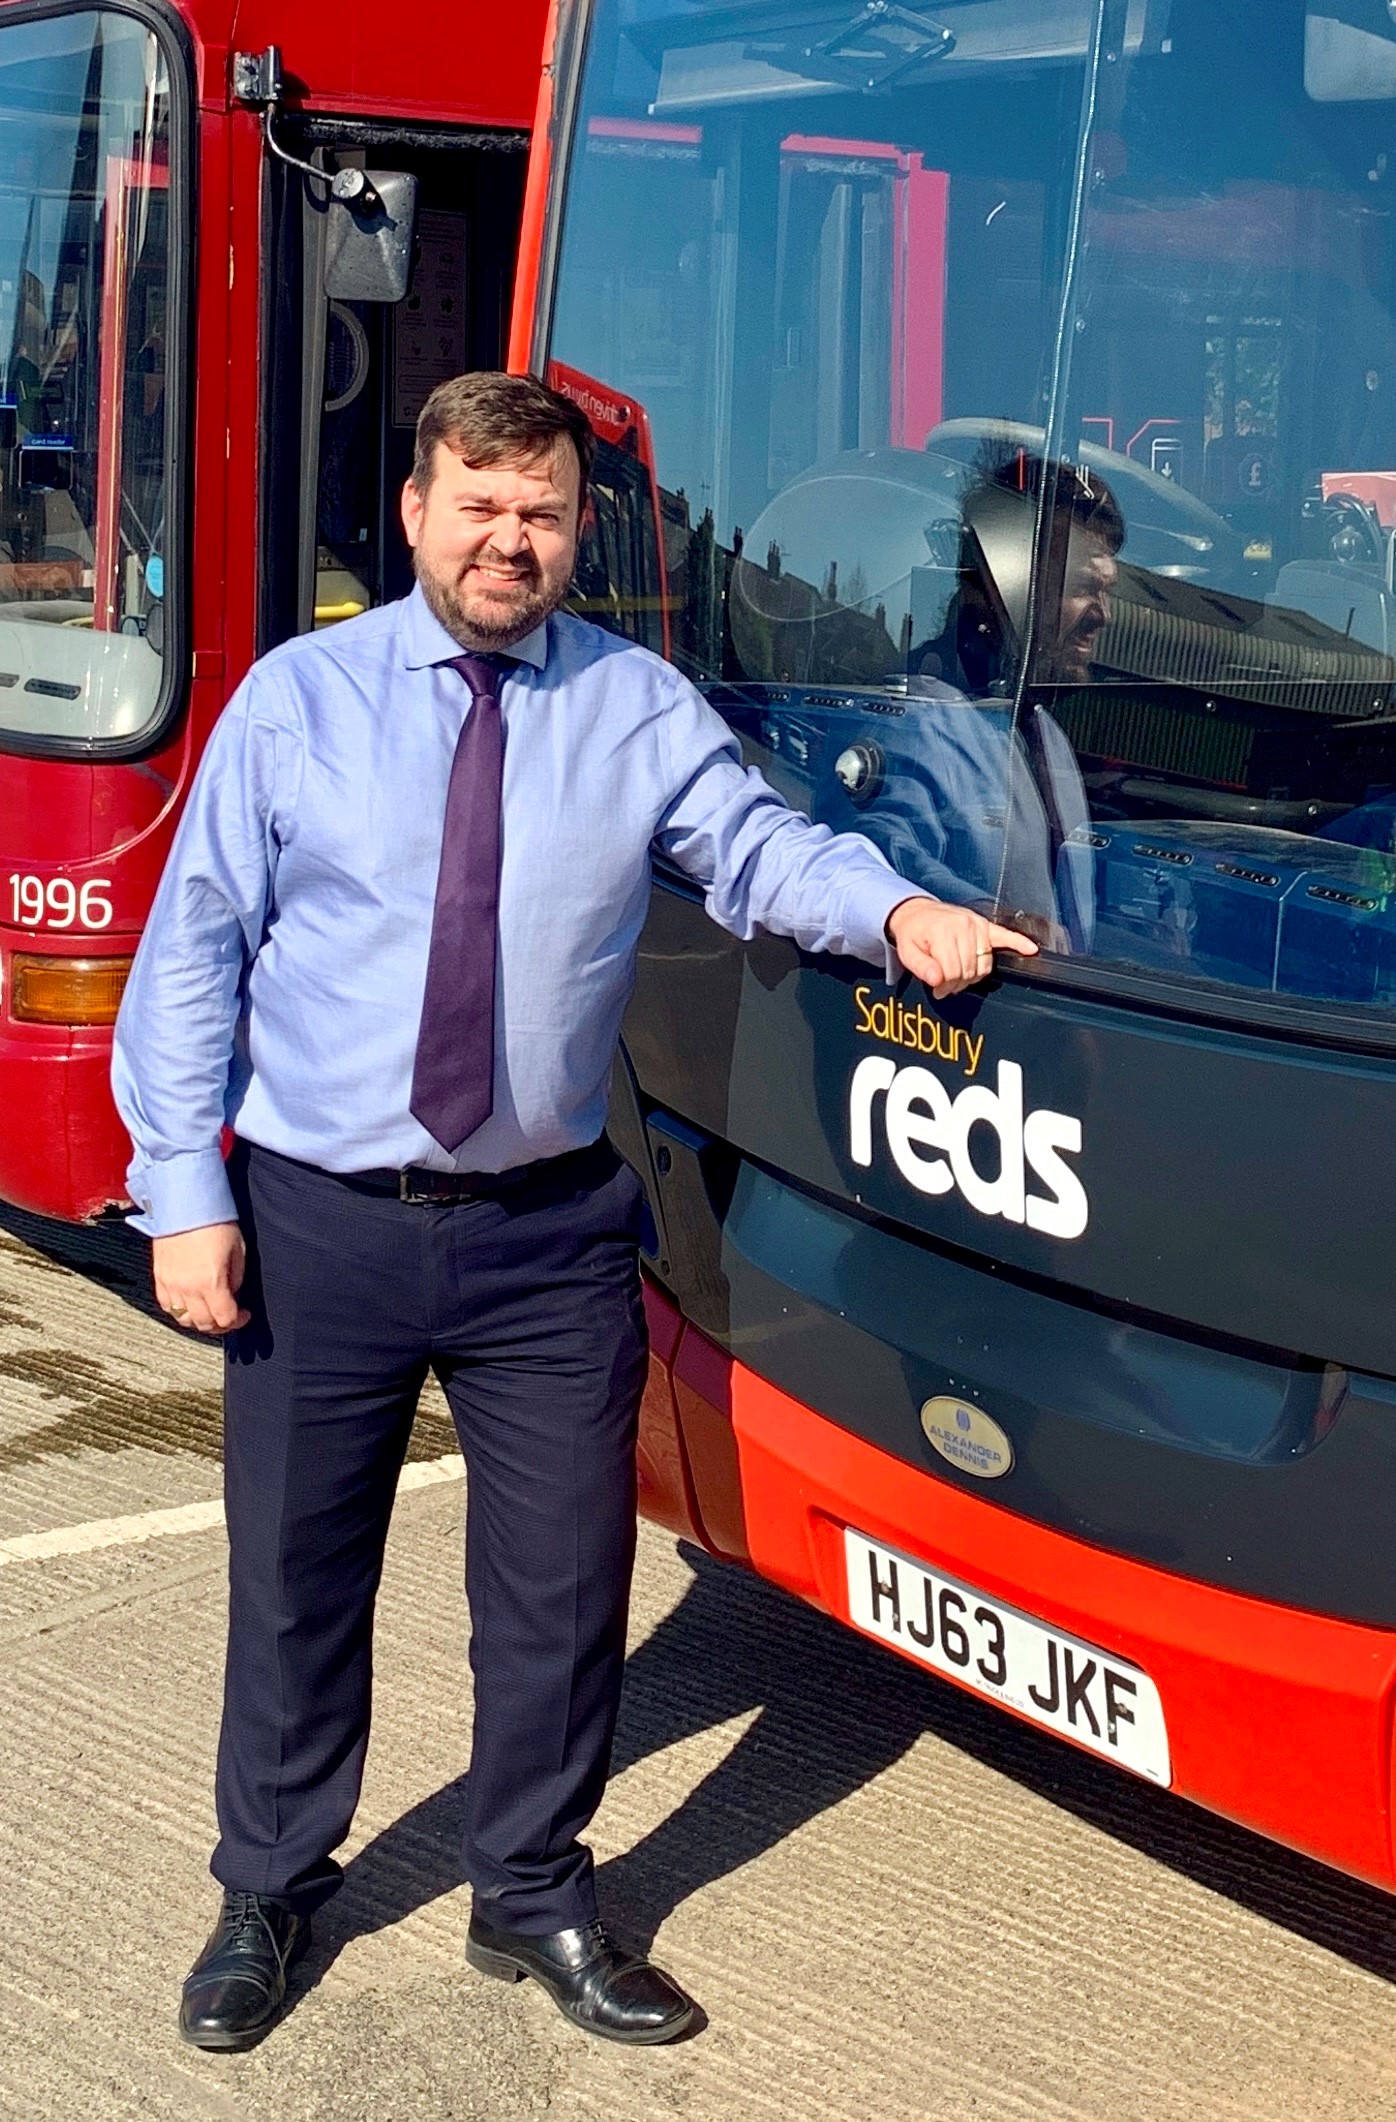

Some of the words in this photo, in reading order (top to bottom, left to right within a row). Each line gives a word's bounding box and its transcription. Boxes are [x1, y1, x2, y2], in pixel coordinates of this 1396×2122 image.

[9, 873, 113, 929] 1996
[855, 986, 985, 1076] Salisbury
[850, 1055, 1089, 1240] reds
[930, 1425, 1002, 1464] ALEXANDER
[943, 1442, 989, 1470] DENNIS
[868, 1550, 1007, 1686] HJ63
[1028, 1639, 1138, 1746] JKF
